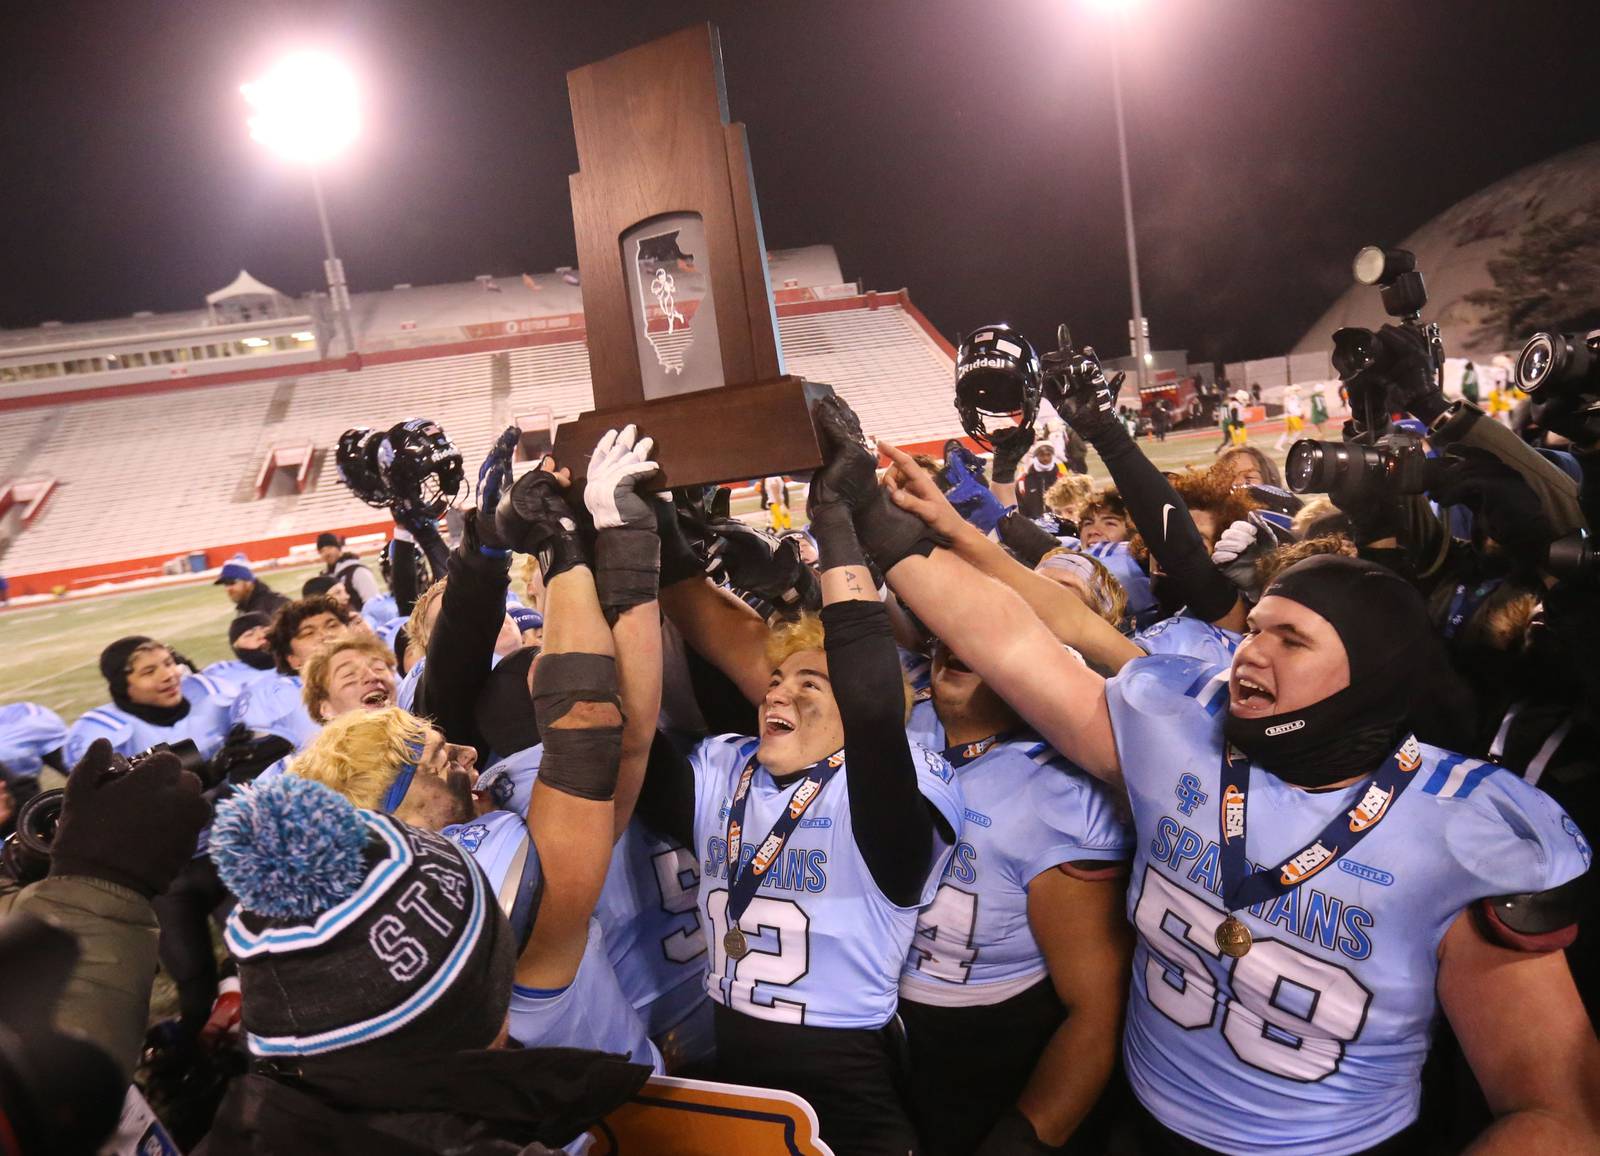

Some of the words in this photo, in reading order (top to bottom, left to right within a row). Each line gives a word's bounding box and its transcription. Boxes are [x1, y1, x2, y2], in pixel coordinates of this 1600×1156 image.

[1268, 721, 1303, 735] BATTLE
[1226, 792, 1245, 838] IHSA
[1348, 783, 1390, 827] IHSA
[751, 833, 784, 871] IHSA
[1280, 842, 1332, 881] IHSA
[1342, 860, 1391, 884] BATTLE
[706, 888, 811, 1024] 12
[1133, 863, 1374, 1083] 58
